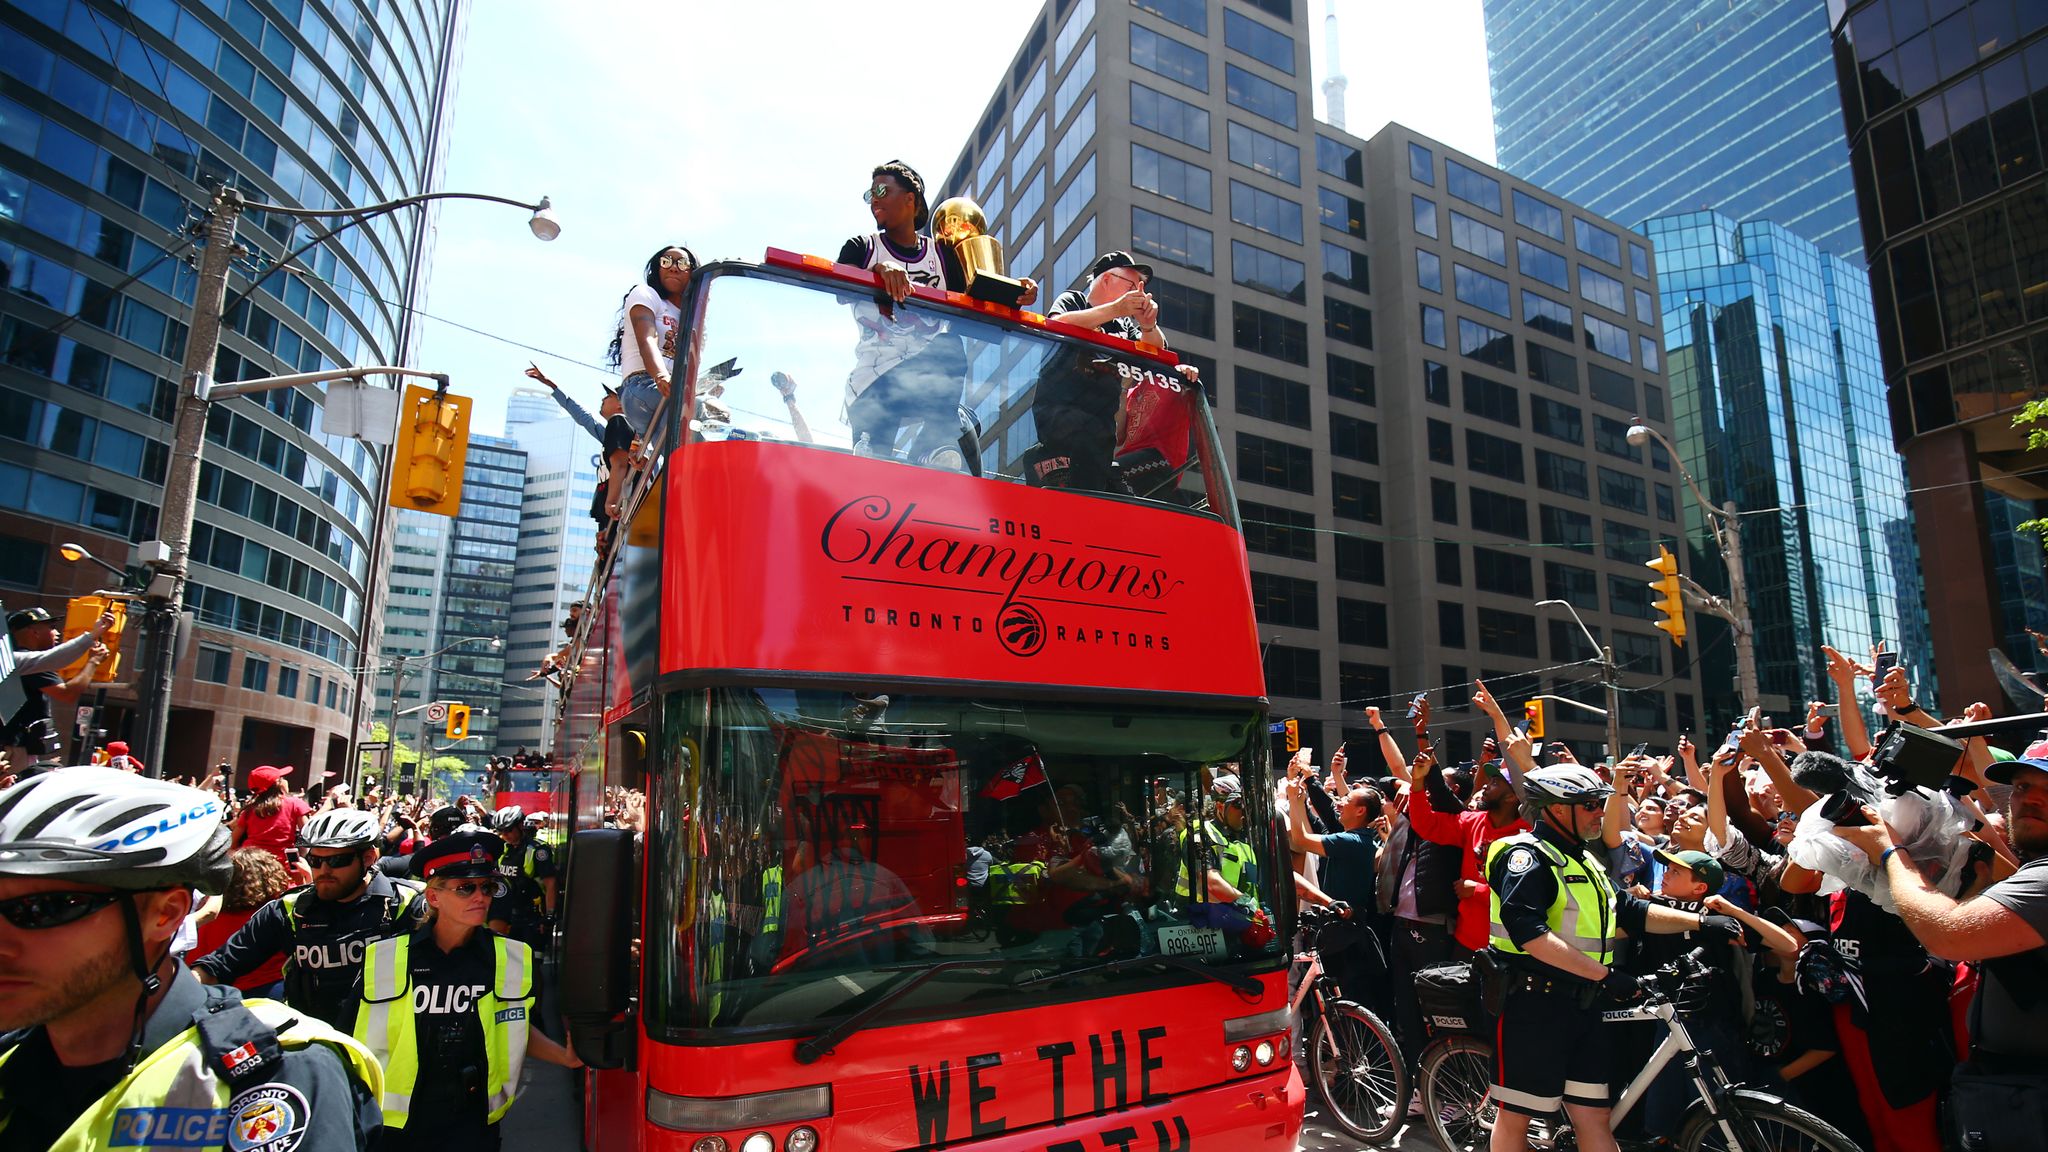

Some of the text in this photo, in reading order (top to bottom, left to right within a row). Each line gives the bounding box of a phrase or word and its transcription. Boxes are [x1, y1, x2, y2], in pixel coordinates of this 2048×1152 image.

[1117, 362, 1181, 393] 85135
[989, 518, 1041, 540] 2019
[820, 495, 1184, 610] Champions
[842, 605, 1170, 651] TORONTO RAPTORS
[94, 801, 217, 850] POLICE
[499, 865, 518, 877] OLICE
[413, 985, 486, 1014] OLIC
[497, 1009, 524, 1021] LICE
[1436, 1017, 1464, 1026] POLICE
[1601, 1010, 1635, 1020] POLICE
[230, 1055, 262, 1077] 10303
[908, 1025, 1172, 1150] WE THE
[114, 1113, 229, 1141] POLICE
[250, 1136, 292, 1152] LICE
